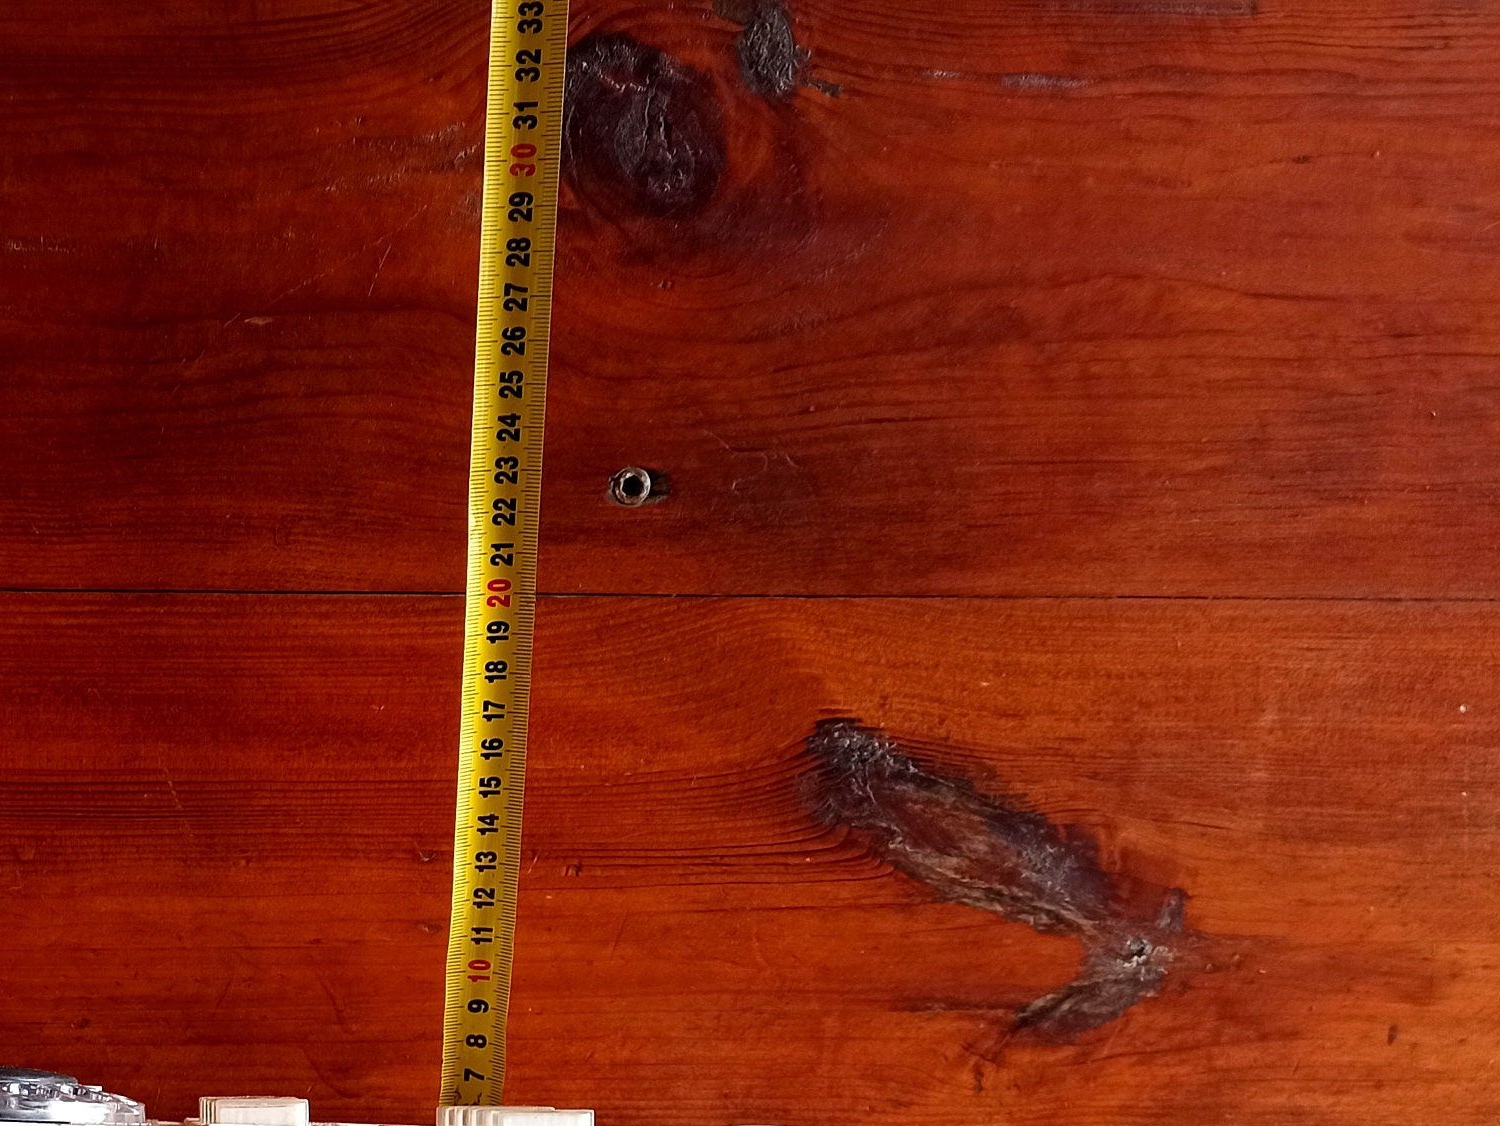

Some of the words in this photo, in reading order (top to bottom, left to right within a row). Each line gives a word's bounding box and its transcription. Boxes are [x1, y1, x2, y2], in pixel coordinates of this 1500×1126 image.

[517, 1, 544, 34] 33
[515, 49, 541, 82] 32
[513, 101, 538, 130] 31
[508, 143, 538, 177] 30
[508, 192, 533, 222] 29
[506, 237, 531, 267] 28
[503, 283, 528, 312] 27
[501, 326, 526, 356] 26
[499, 370, 523, 399] 25
[496, 413, 521, 442] 24
[494, 456, 518, 484] 23
[492, 498, 516, 526] 22
[490, 543, 514, 566] 21
[487, 579, 511, 608] 20
[487, 621, 509, 643] 19
[485, 661, 507, 683] 18
[483, 701, 505, 721] 17
[481, 738, 503, 760] 16
[479, 777, 501, 798] 15
[477, 814, 499, 835] 14
[475, 852, 497, 872] 13
[473, 888, 495, 908] 12
[471, 928, 493, 944] 11
[467, 958, 493, 984] 10
[468, 999, 489, 1013] 9
[466, 1035, 486, 1048] 8
[464, 1068, 484, 1081] 7
